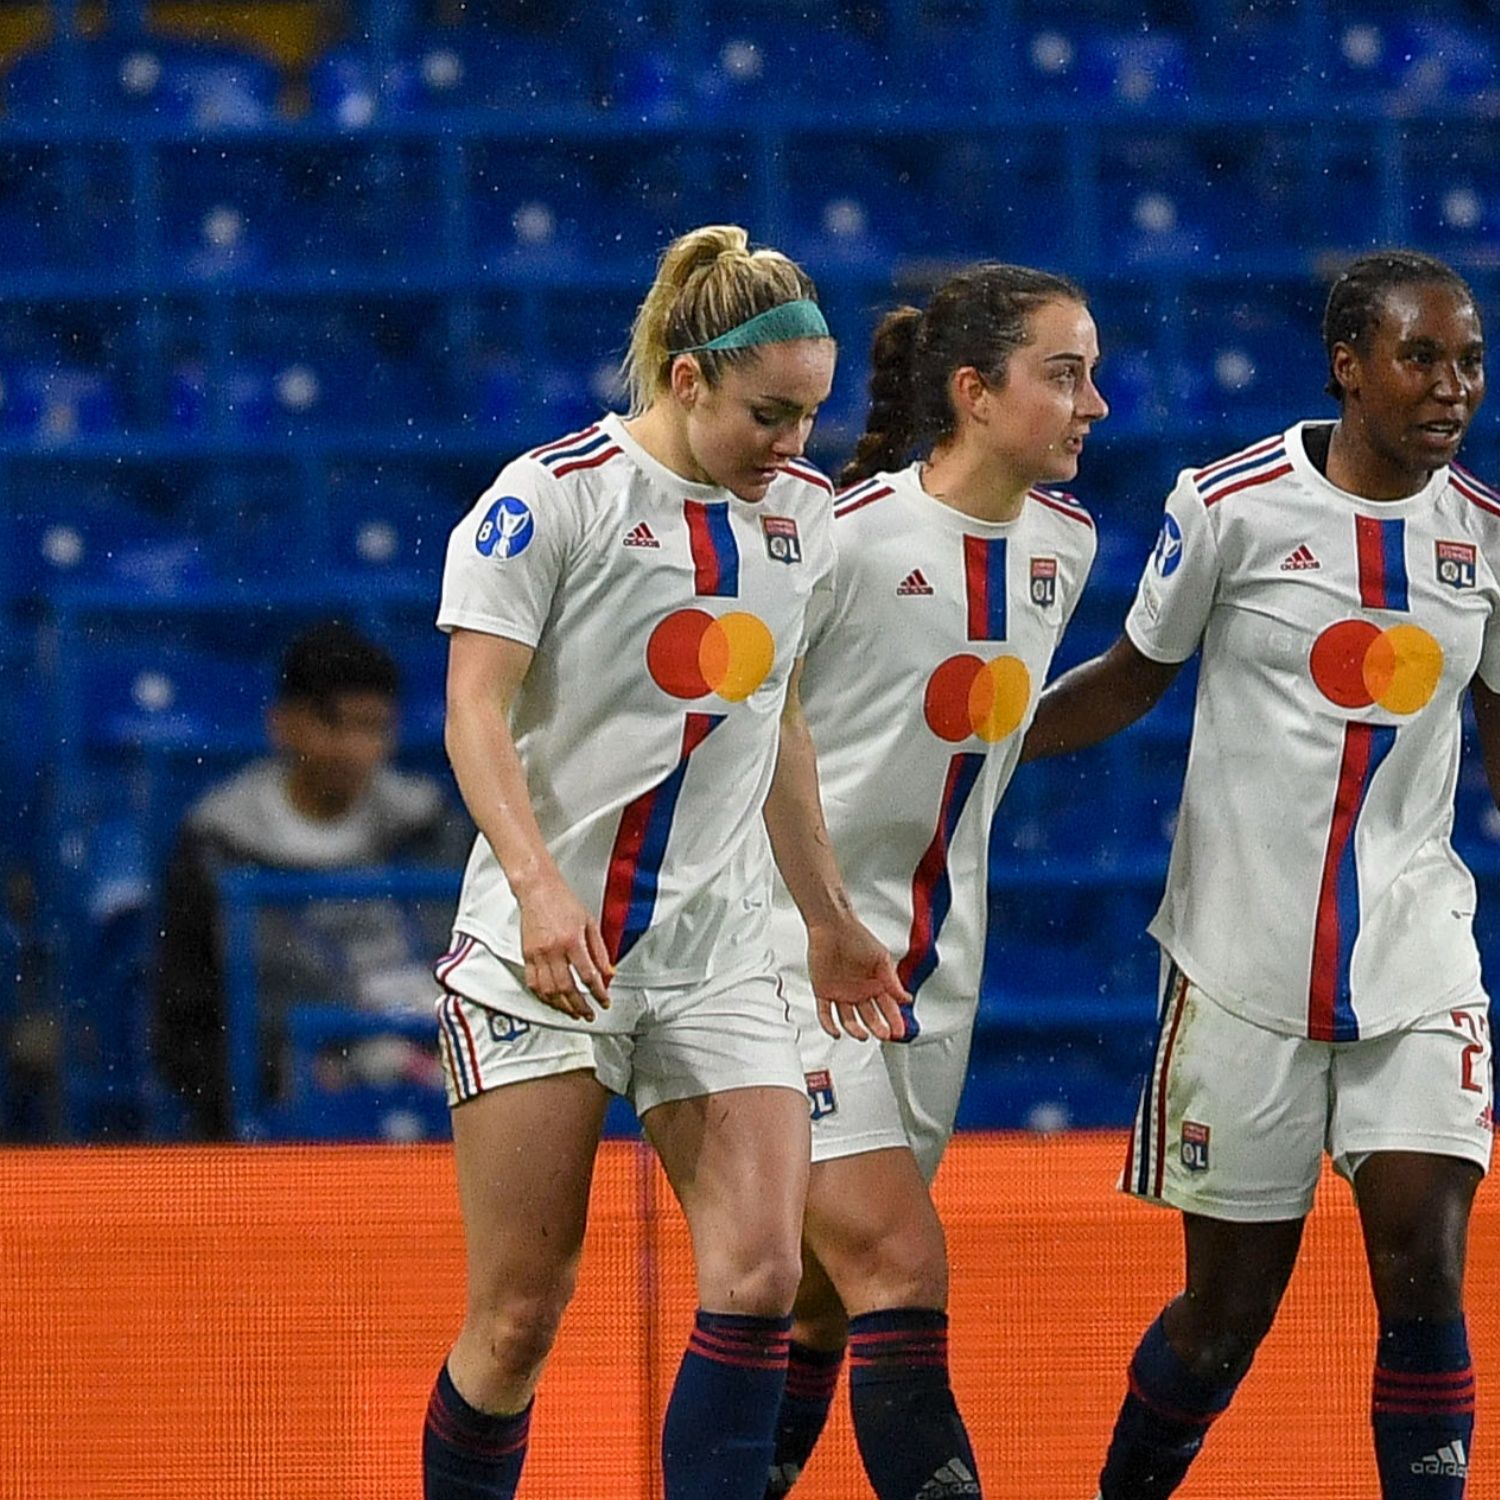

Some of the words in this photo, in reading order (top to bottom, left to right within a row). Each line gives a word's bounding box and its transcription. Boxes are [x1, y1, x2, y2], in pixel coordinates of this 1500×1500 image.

[478, 521, 494, 542] 8
[770, 536, 799, 559] OL
[1441, 560, 1473, 586] OL
[1450, 1010, 1486, 1095] 2
[1182, 1142, 1206, 1168] OL
